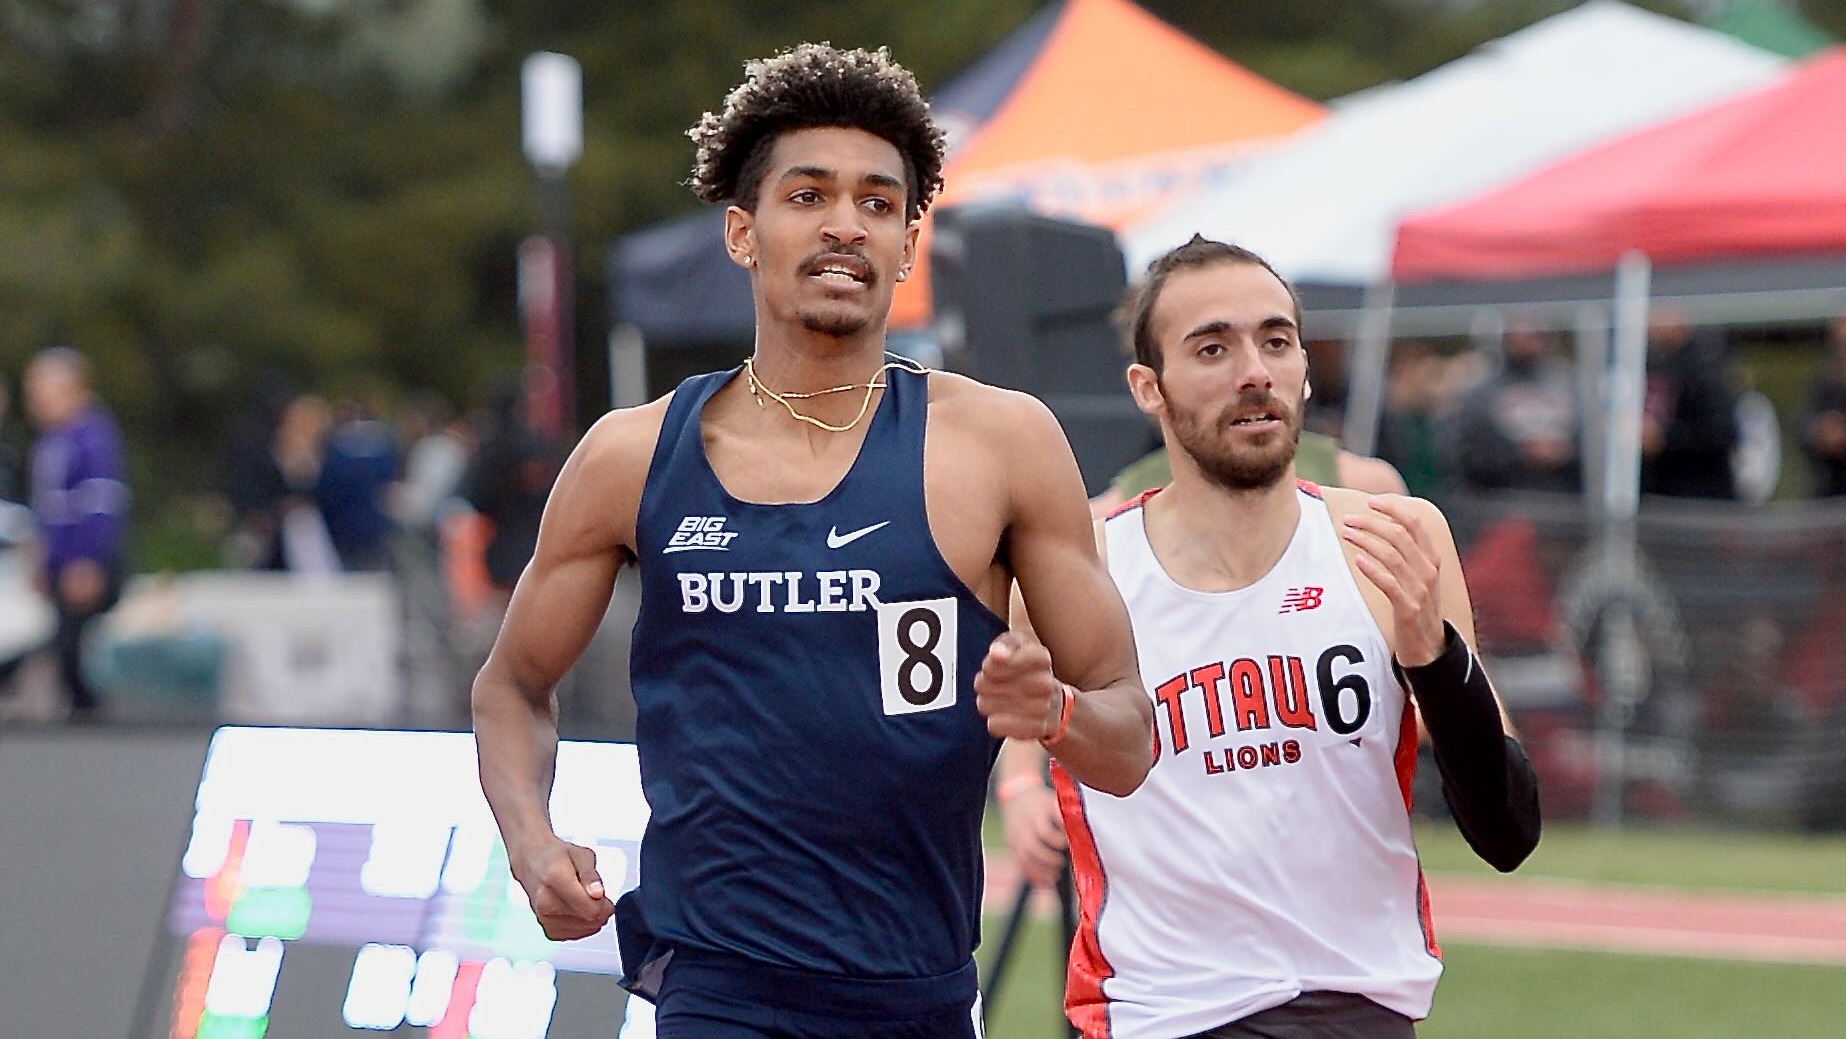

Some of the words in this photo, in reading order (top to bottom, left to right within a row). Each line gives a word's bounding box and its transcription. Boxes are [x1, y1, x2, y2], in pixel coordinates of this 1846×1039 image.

[668, 532, 739, 547] EAST
[677, 516, 727, 532] BIG
[677, 570, 881, 613] BUTLER
[896, 607, 944, 706] 8
[1316, 644, 1371, 735] 6
[1203, 740, 1302, 775] LIONS
